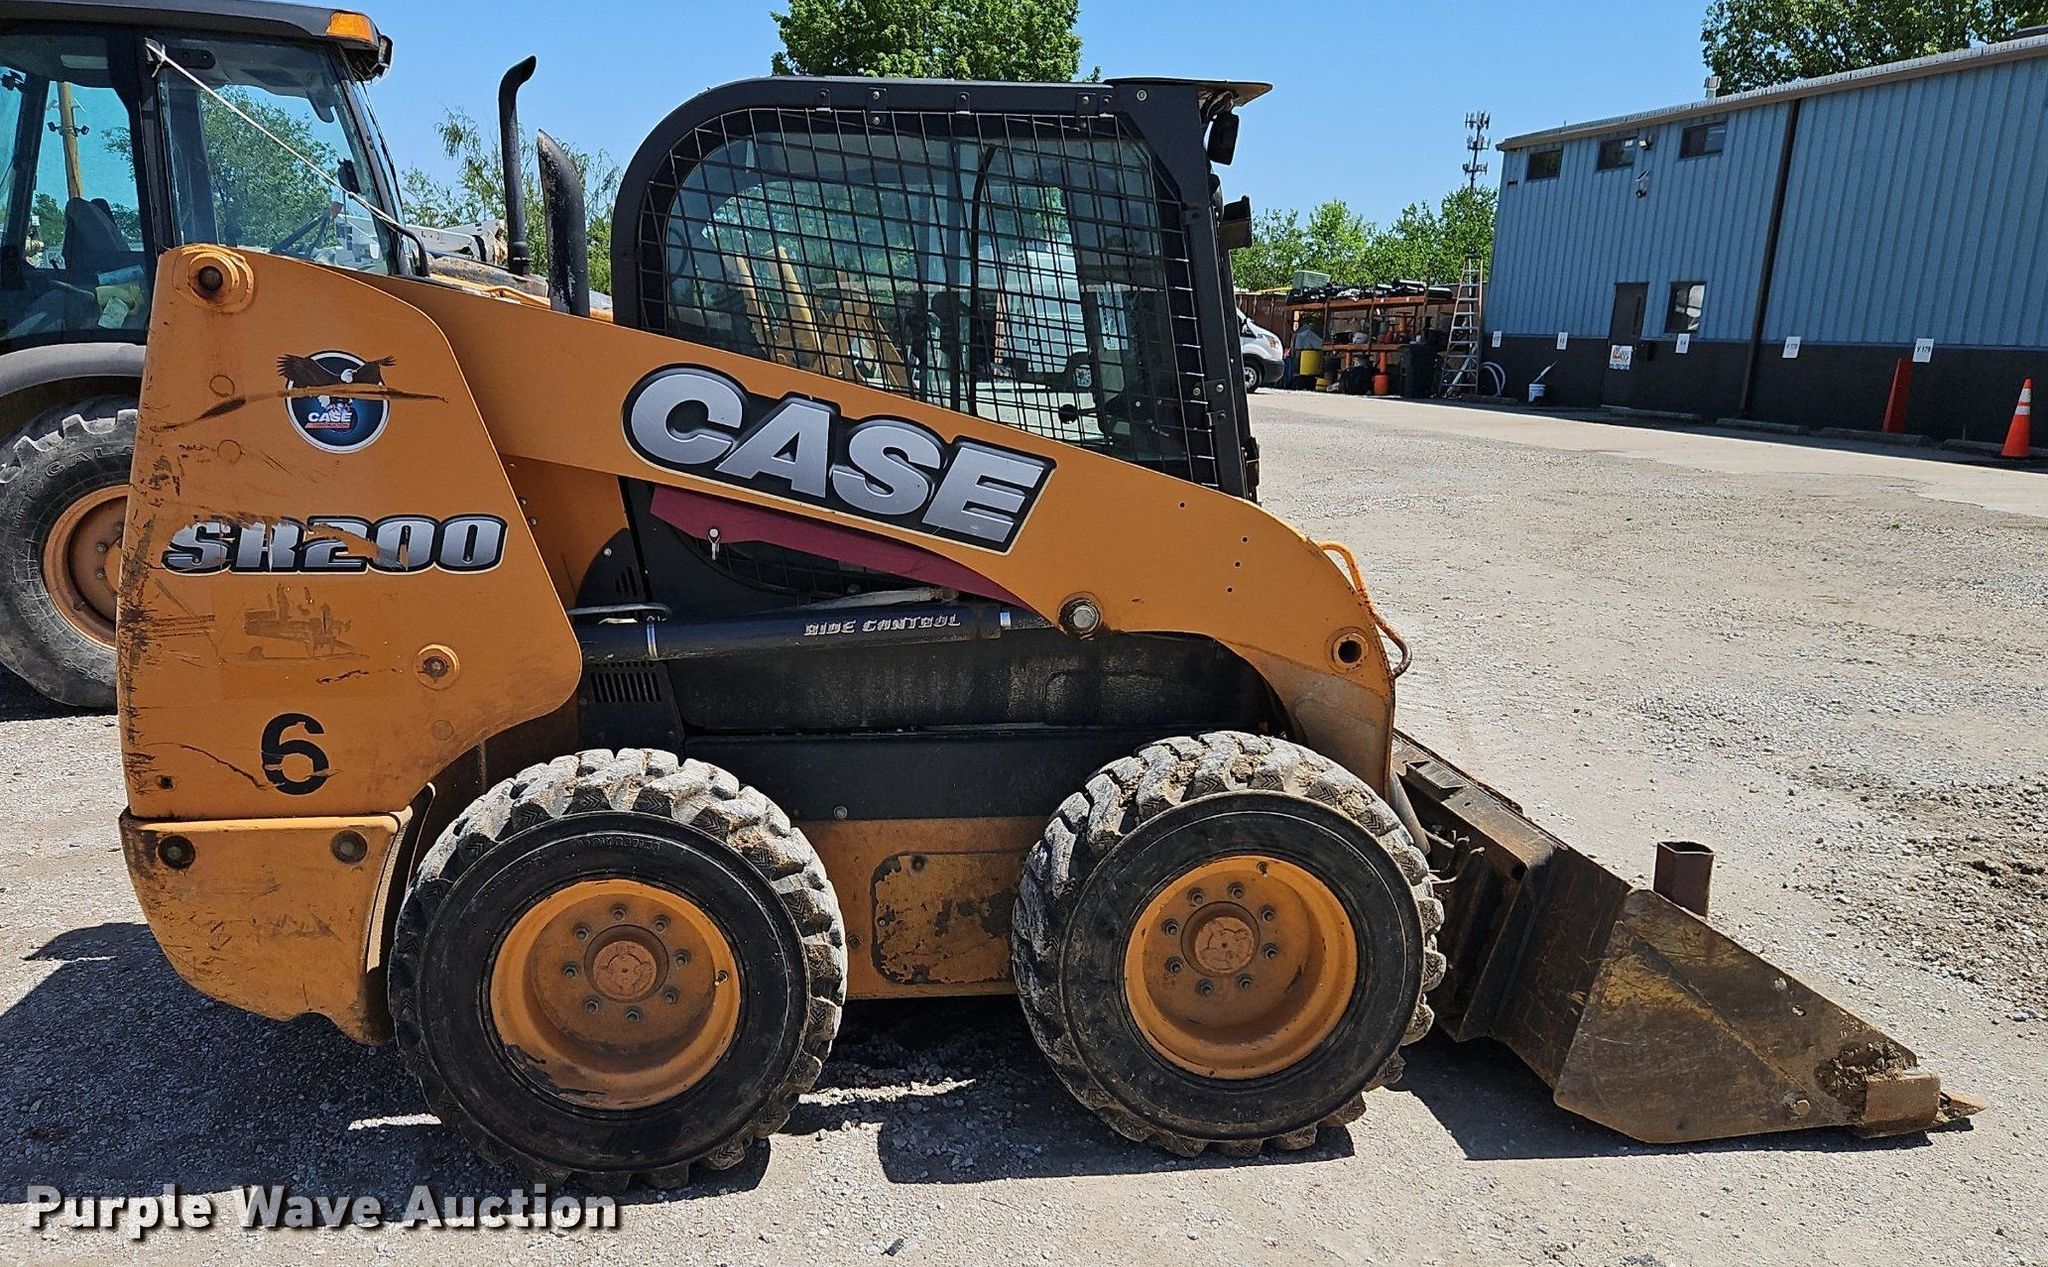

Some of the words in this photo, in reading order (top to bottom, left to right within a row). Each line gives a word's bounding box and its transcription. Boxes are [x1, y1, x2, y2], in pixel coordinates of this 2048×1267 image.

[307, 412, 352, 422] CASE
[626, 368, 1052, 550] CASE
[161, 513, 508, 575] SR200
[803, 619, 857, 637] RIDE
[862, 613, 961, 633] CONTROL
[261, 713, 329, 795] 6
